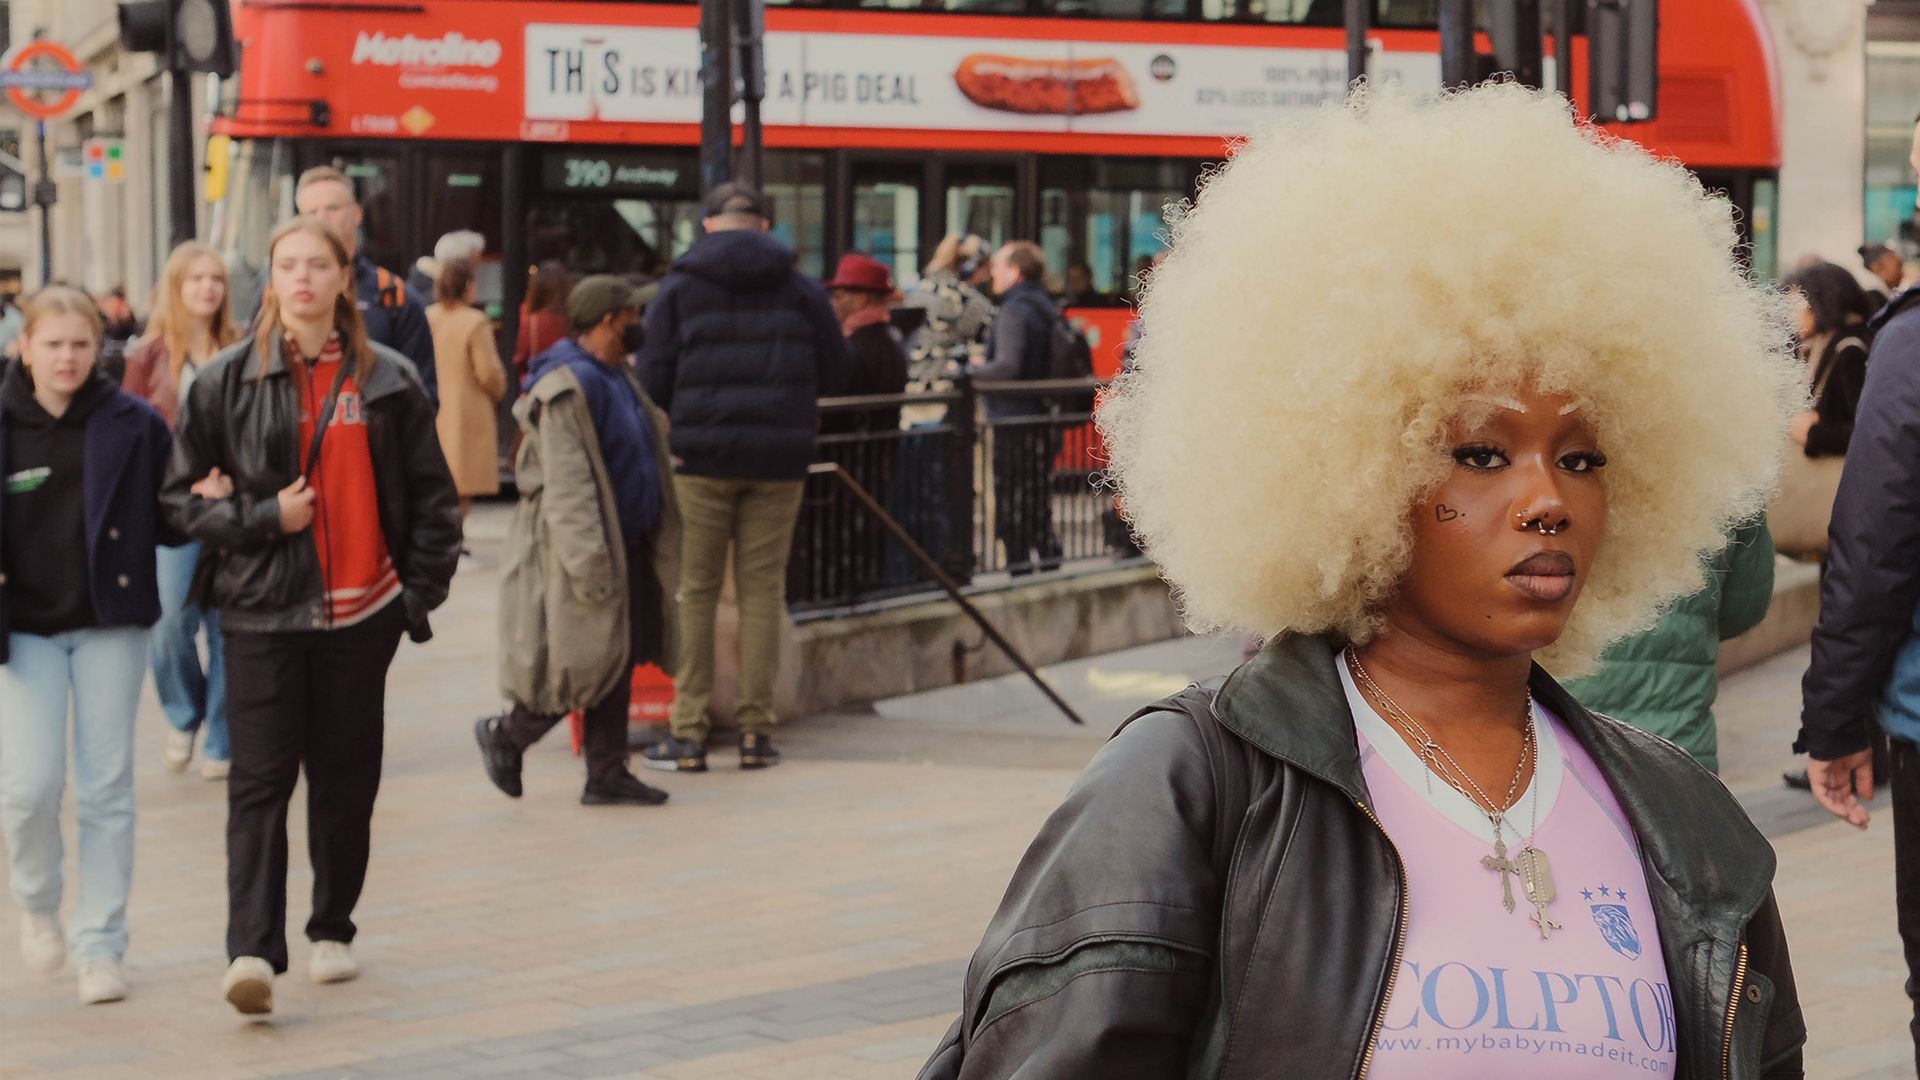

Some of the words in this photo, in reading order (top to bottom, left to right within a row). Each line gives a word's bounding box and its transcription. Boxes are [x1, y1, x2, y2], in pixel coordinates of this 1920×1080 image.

[351, 31, 502, 67] Metroline
[545, 48, 620, 94] THS
[631, 66, 655, 97] IS
[778, 70, 794, 99] A
[803, 71, 848, 102] PIG
[856, 72, 920, 104] DEAL
[564, 159, 612, 188] 390
